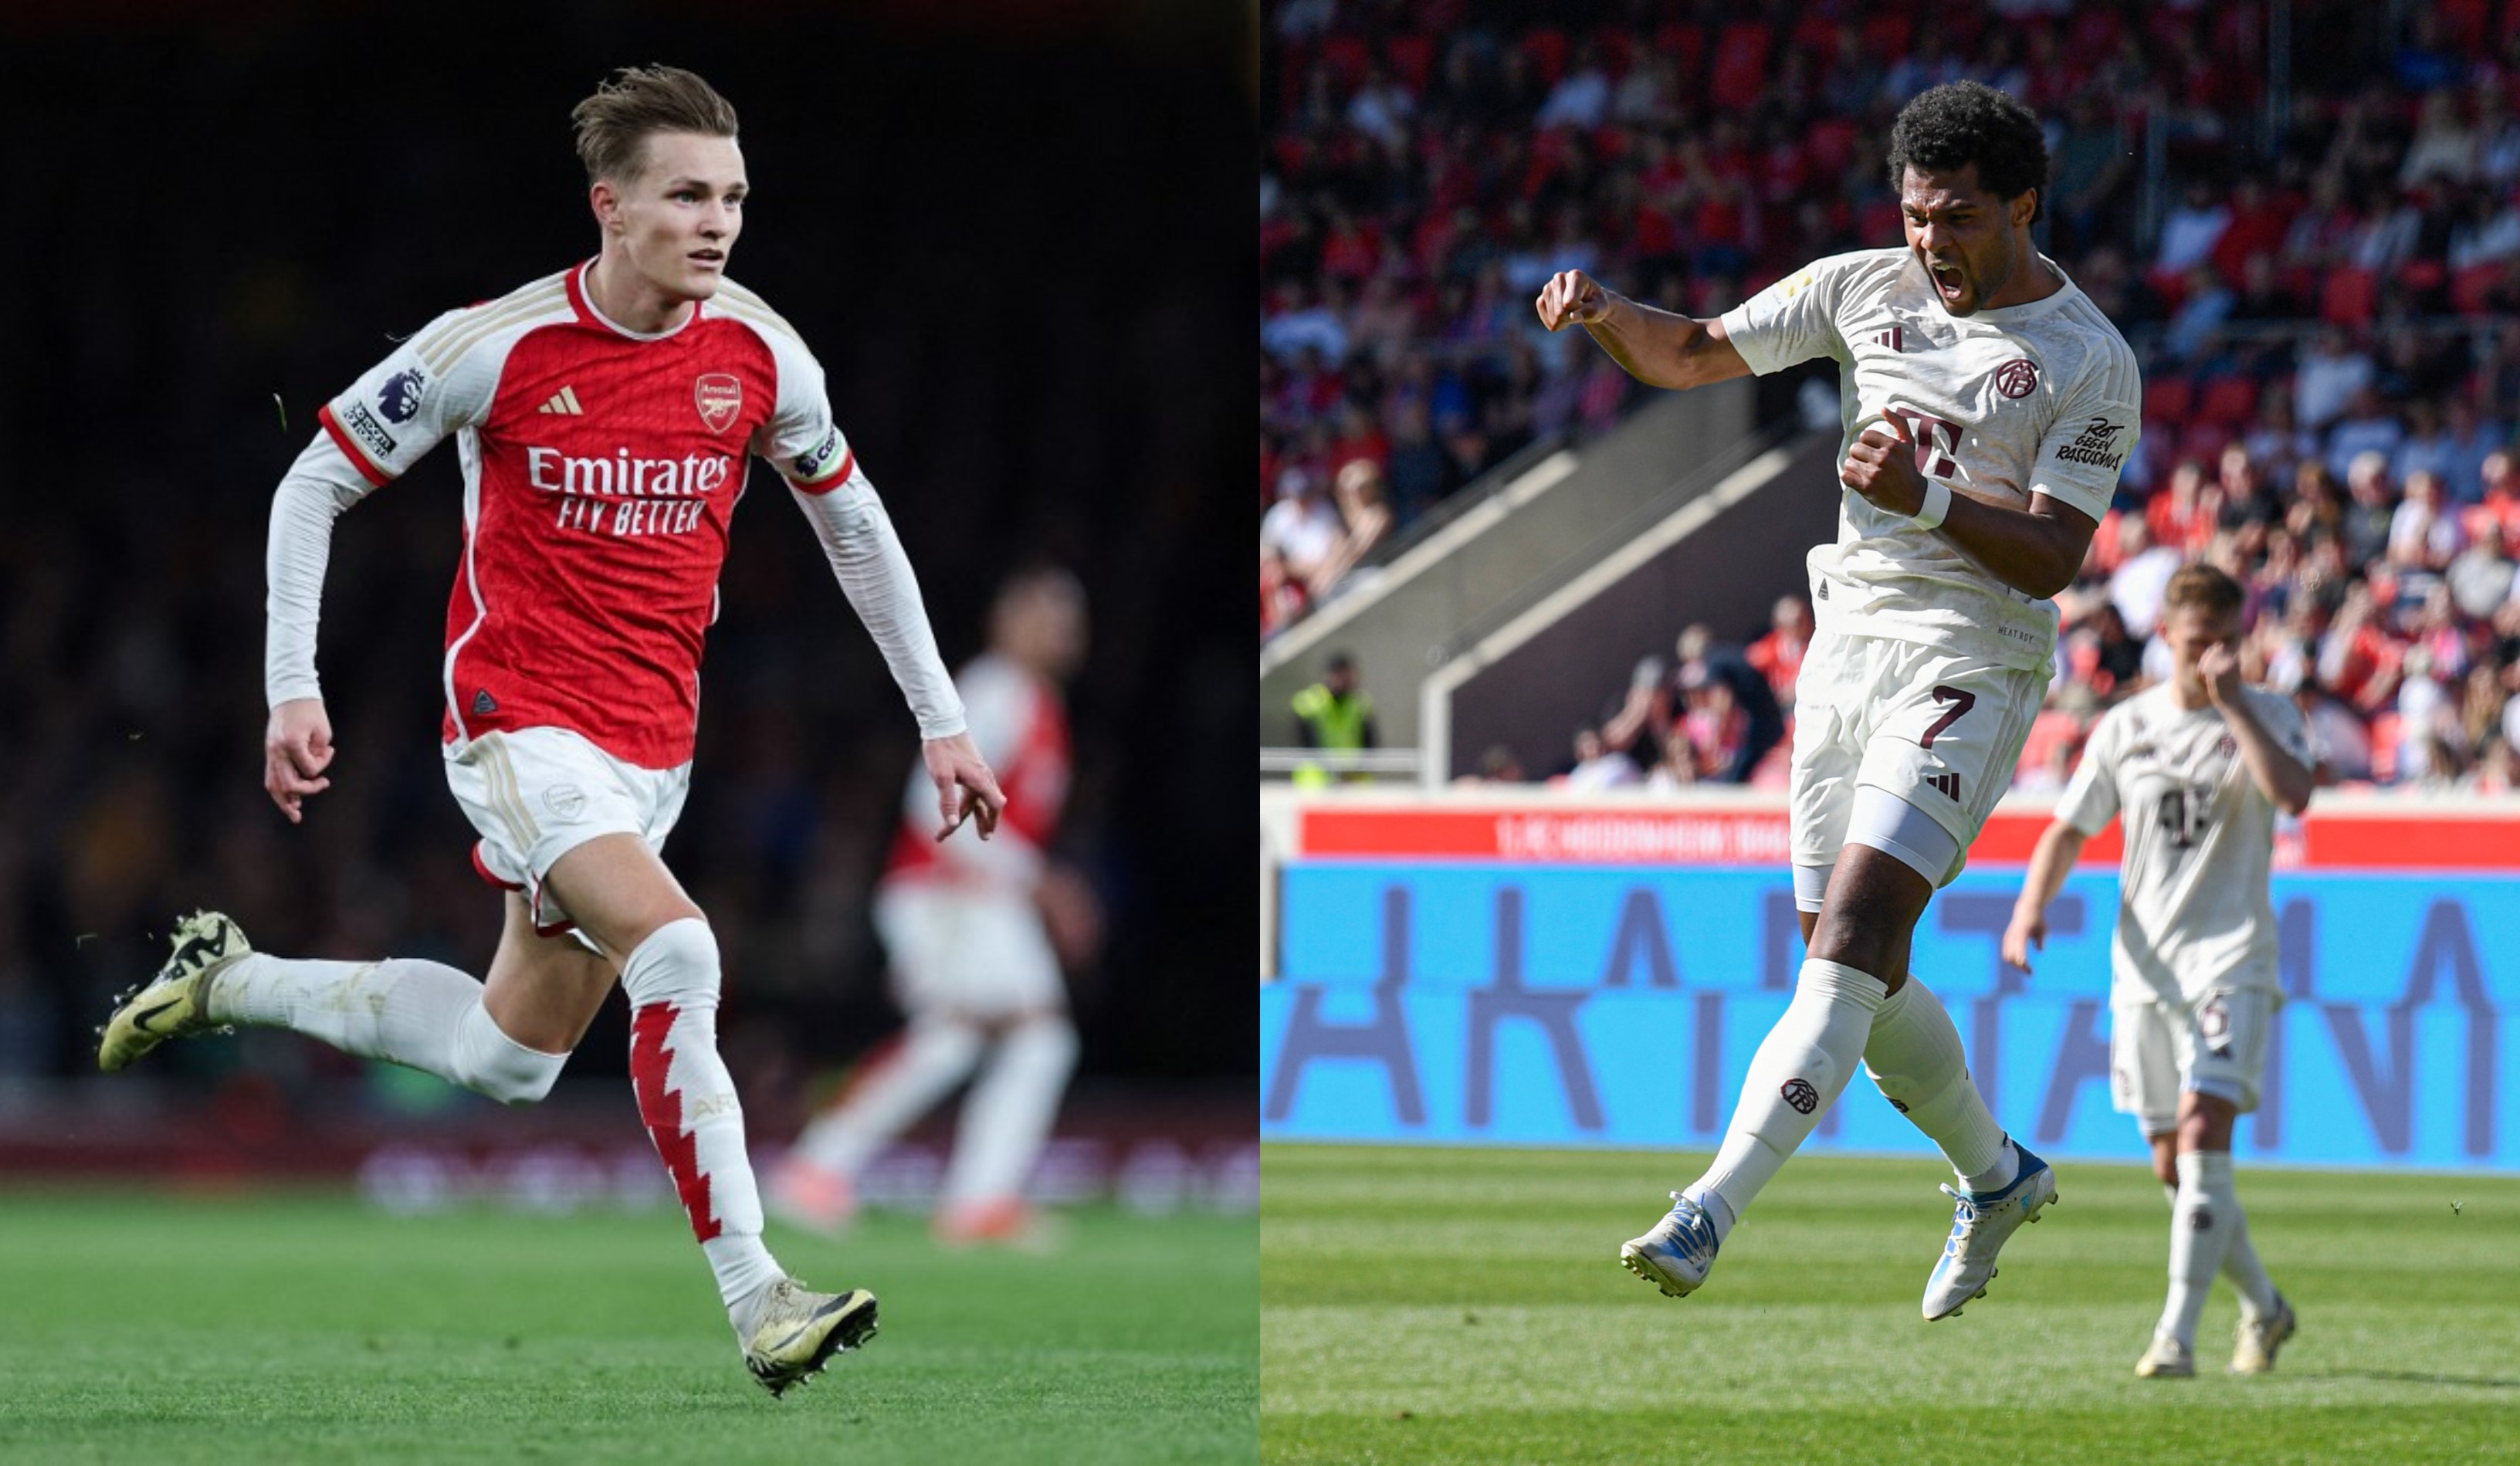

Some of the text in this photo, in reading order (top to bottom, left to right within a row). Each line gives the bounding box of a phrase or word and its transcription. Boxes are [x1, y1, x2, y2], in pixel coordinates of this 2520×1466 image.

[2055, 445, 2122, 472] RASSISMUS
[2075, 435, 2117, 452] GEGEN
[527, 445, 730, 496] Emirates
[556, 496, 706, 537] FLY BETTER
[1920, 685, 1976, 750] 7
